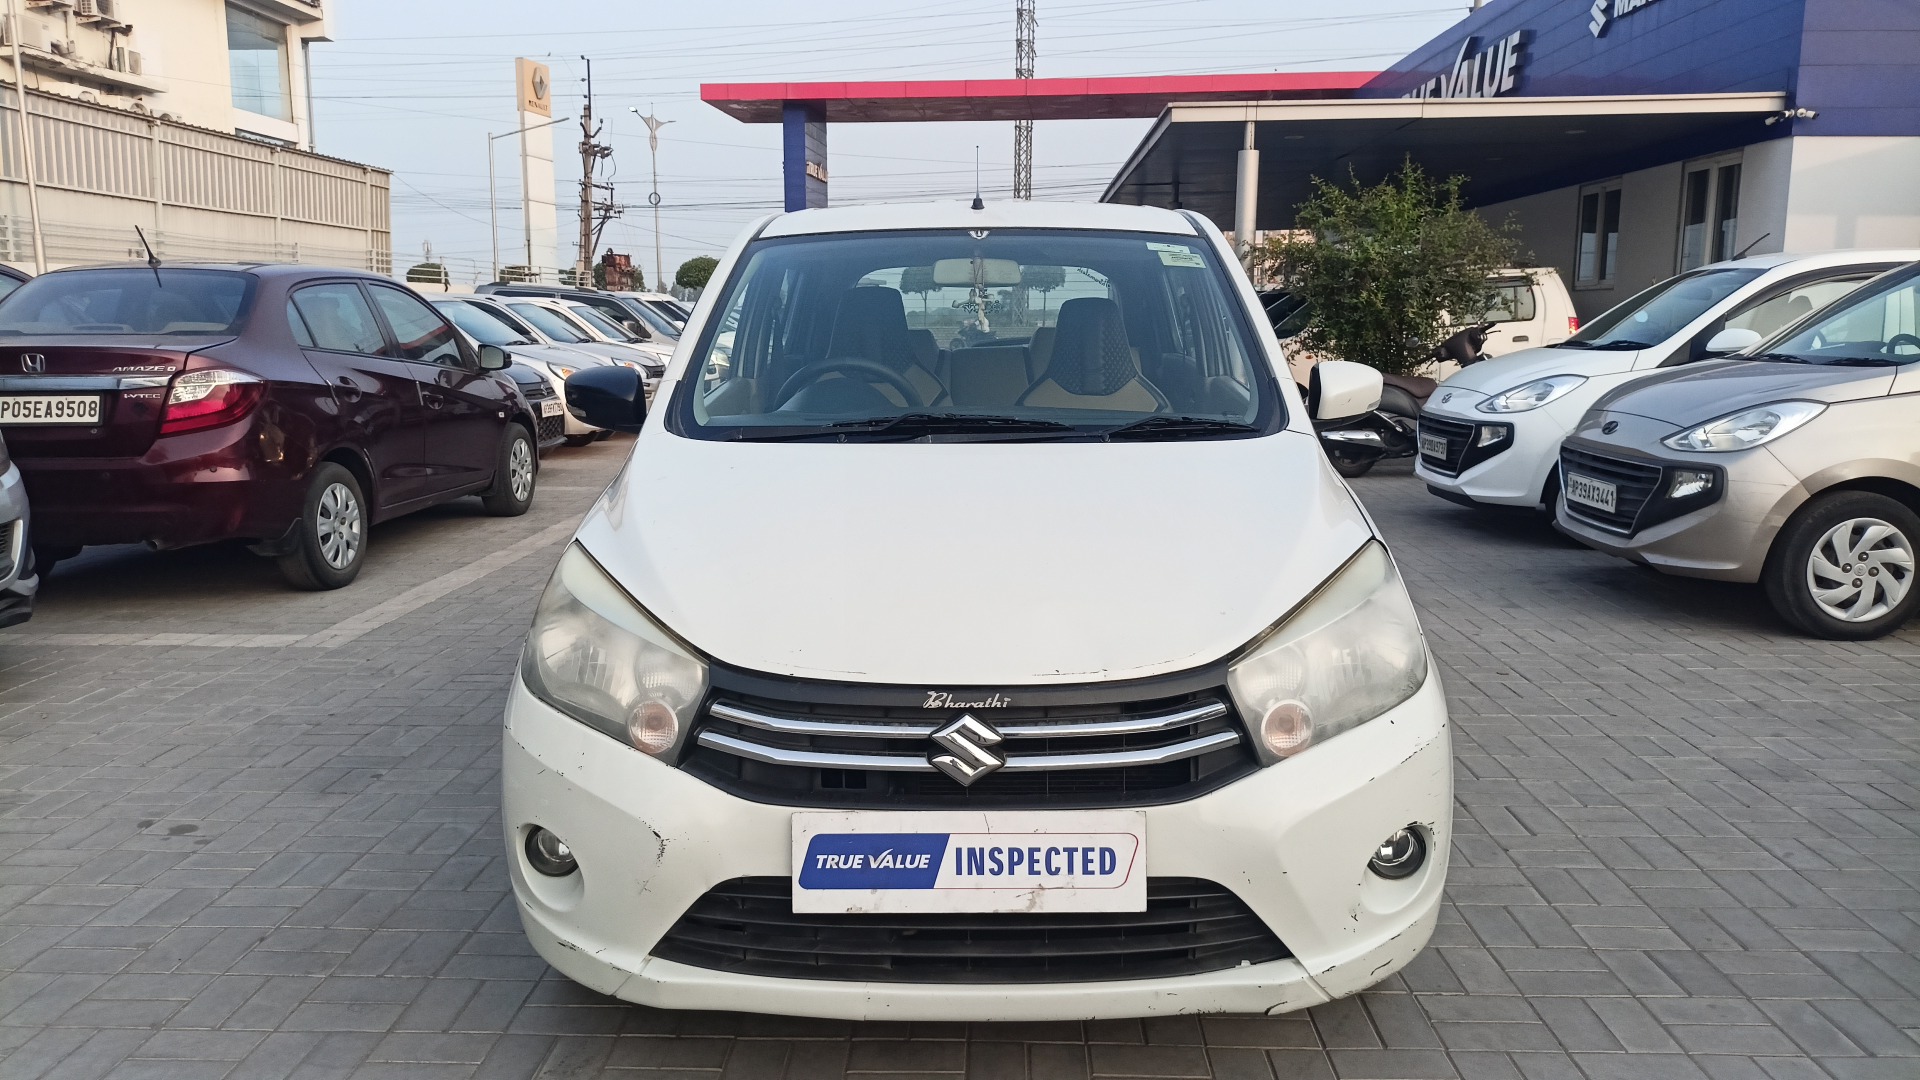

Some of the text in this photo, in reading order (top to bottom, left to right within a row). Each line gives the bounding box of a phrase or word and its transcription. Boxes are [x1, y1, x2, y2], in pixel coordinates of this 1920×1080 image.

[112, 365, 166, 373] AMAZE
[0, 400, 98, 419] P05EA9508
[923, 691, 1011, 708] Bharathi
[816, 847, 1117, 876] TRUE VALUE INSPECTED
